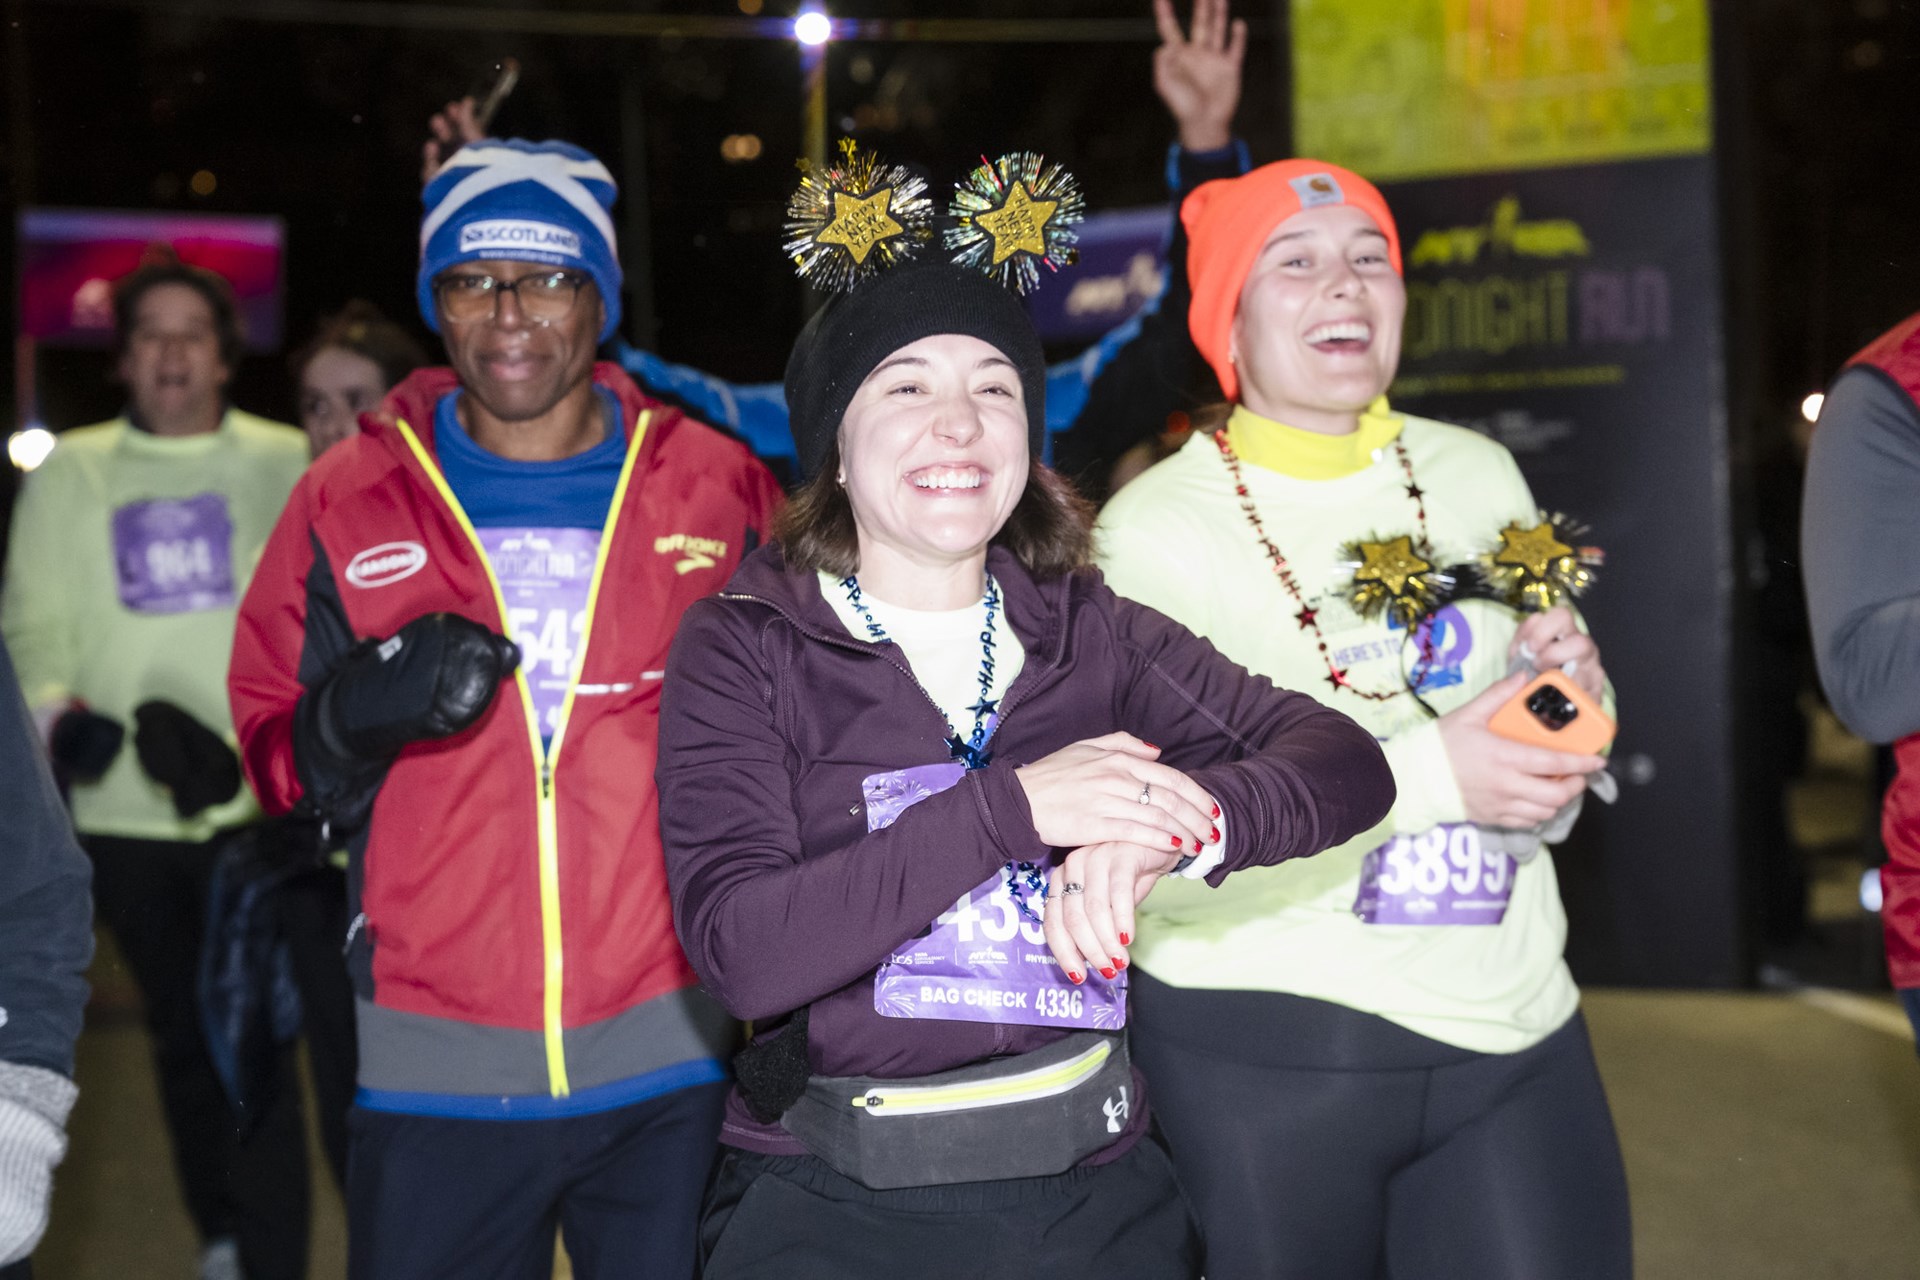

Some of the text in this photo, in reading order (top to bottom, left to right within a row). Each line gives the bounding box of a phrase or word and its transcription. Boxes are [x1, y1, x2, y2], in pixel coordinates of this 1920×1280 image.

[831, 201, 876, 235] HAPPY
[847, 213, 877, 240] NEW
[486, 226, 580, 248] SCOTLAND
[852, 221, 889, 249] YEAR
[920, 986, 1083, 1019] BAG CHECK 4336
